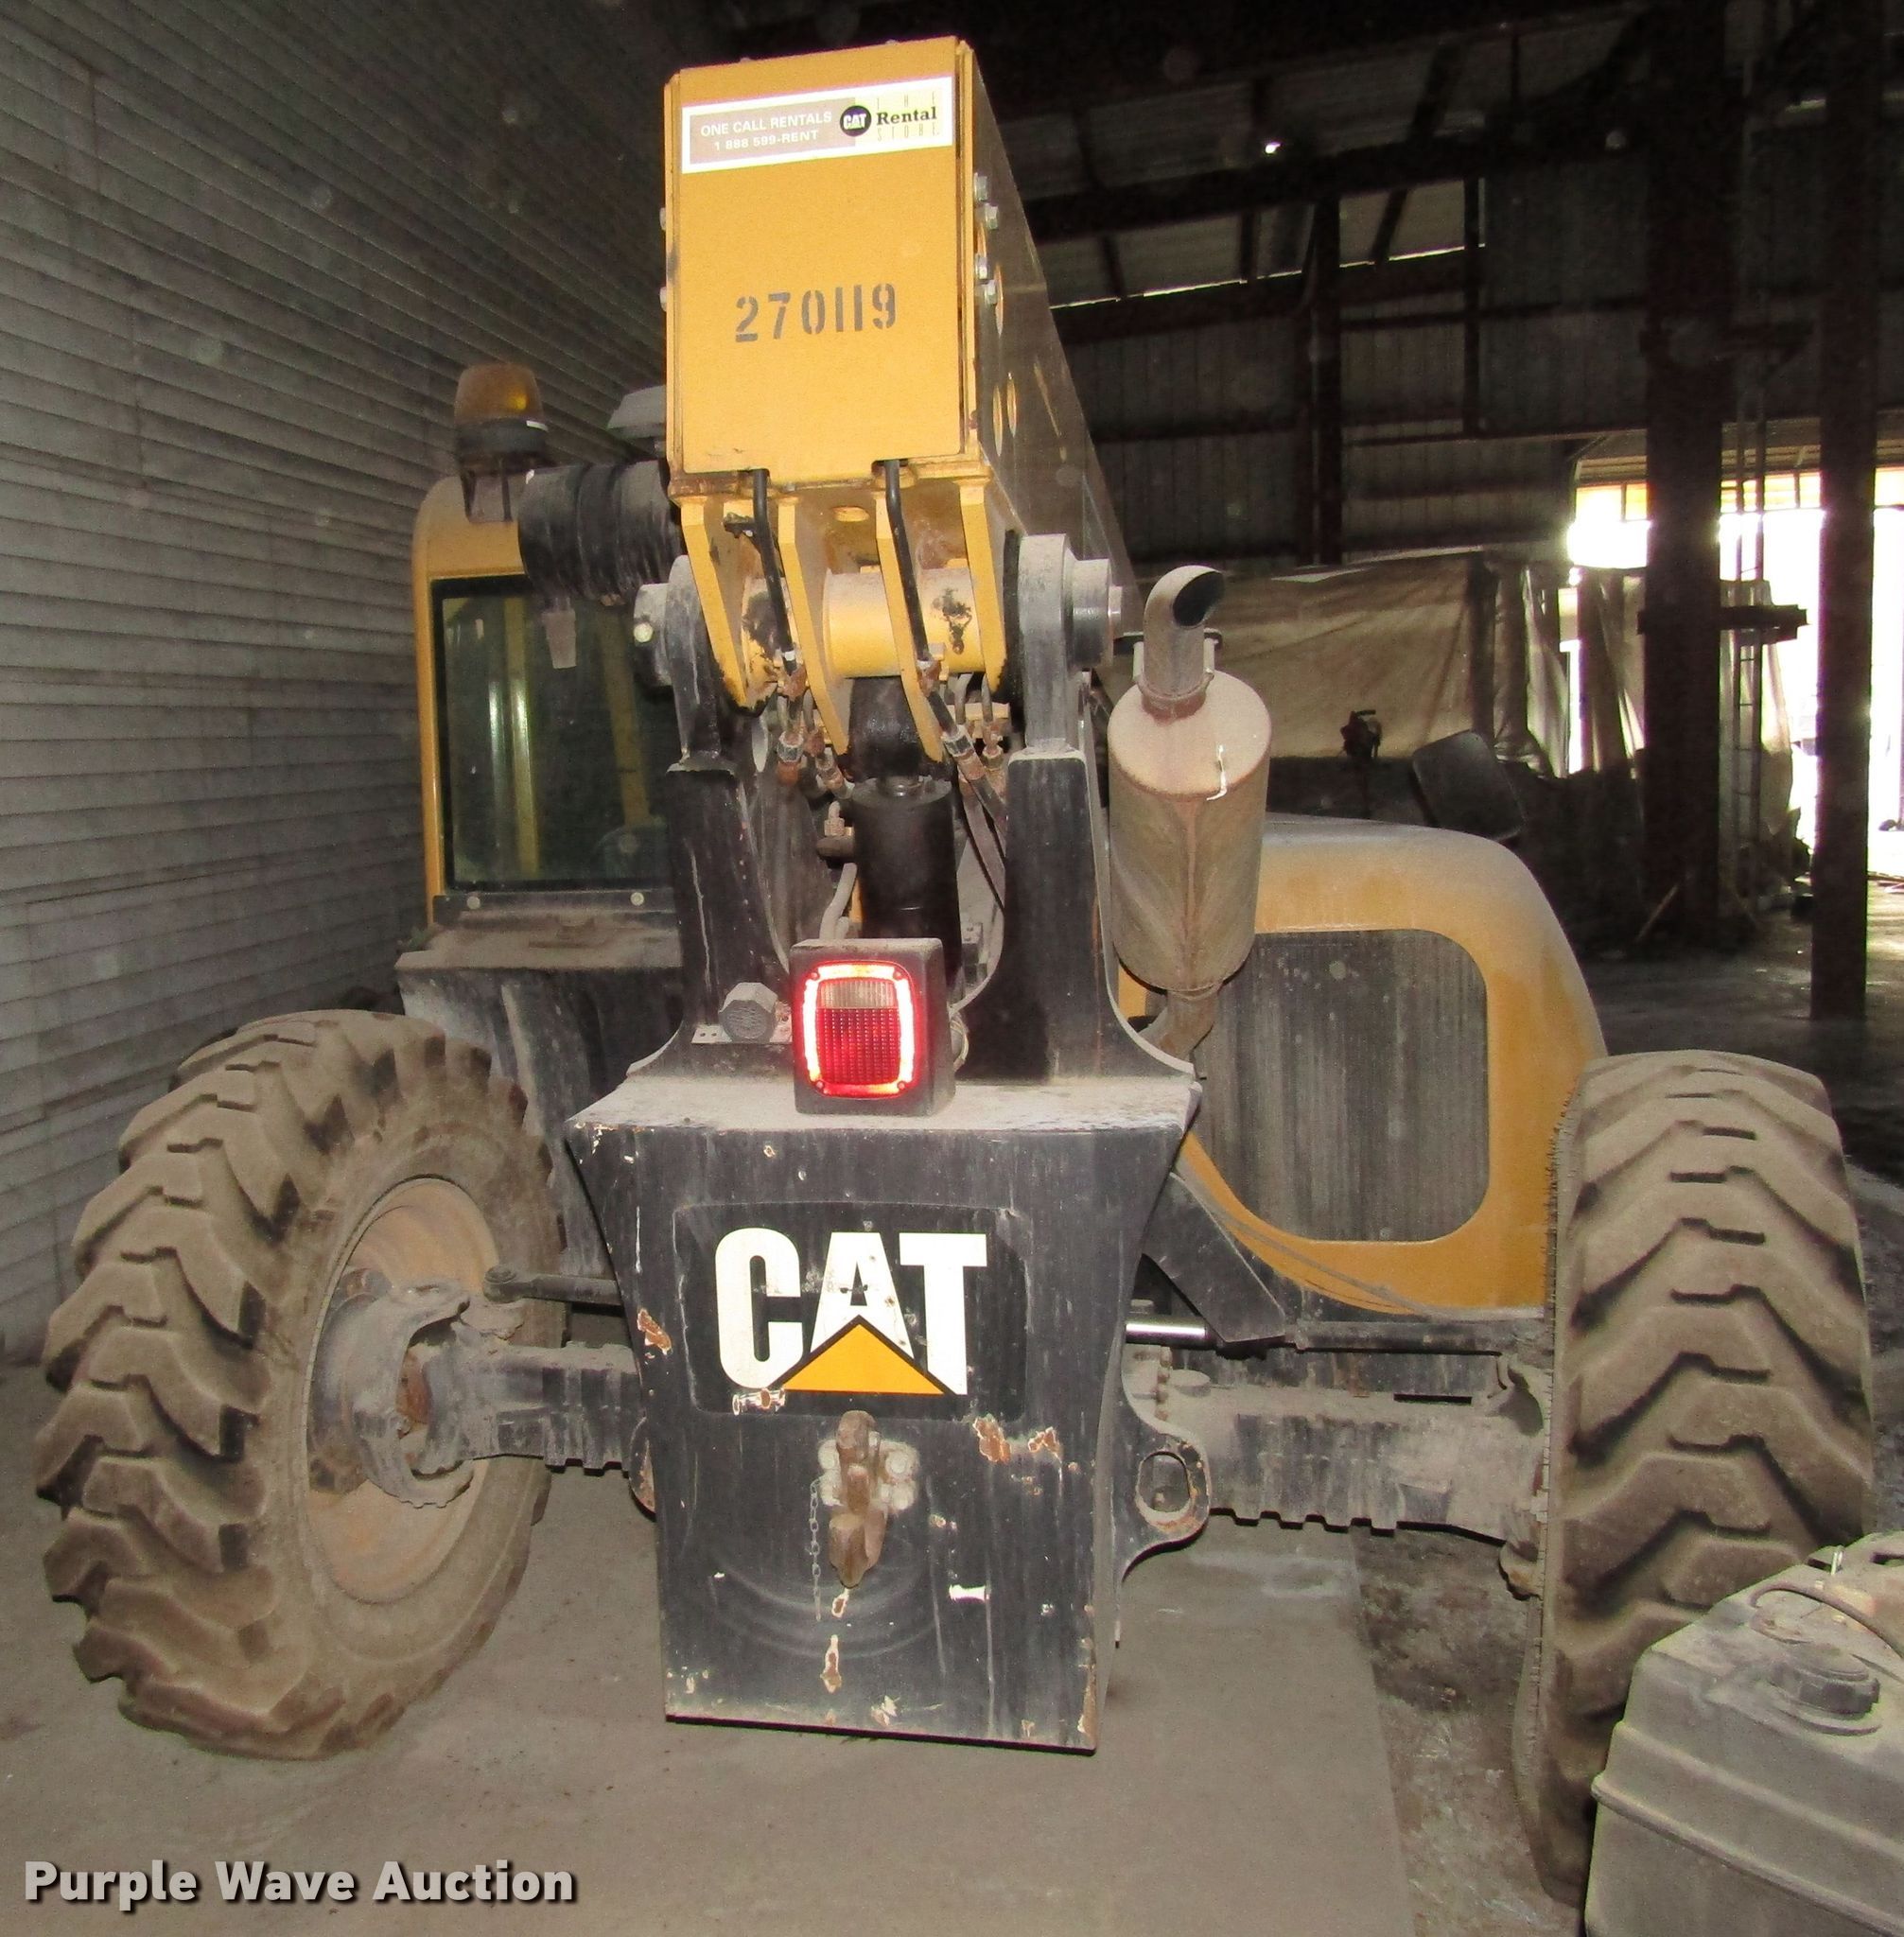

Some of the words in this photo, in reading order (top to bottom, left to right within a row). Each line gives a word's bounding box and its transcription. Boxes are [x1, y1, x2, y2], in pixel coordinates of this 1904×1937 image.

[701, 123, 728, 136] ONE
[733, 119, 766, 132] CALL
[771, 112, 832, 129] RENTALS
[843, 113, 867, 130] CAT
[876, 106, 937, 125] Rental
[714, 141, 720, 150] 1
[725, 138, 749, 149] 888
[735, 284, 896, 342] 270119
[715, 1228, 987, 1395] CAT
